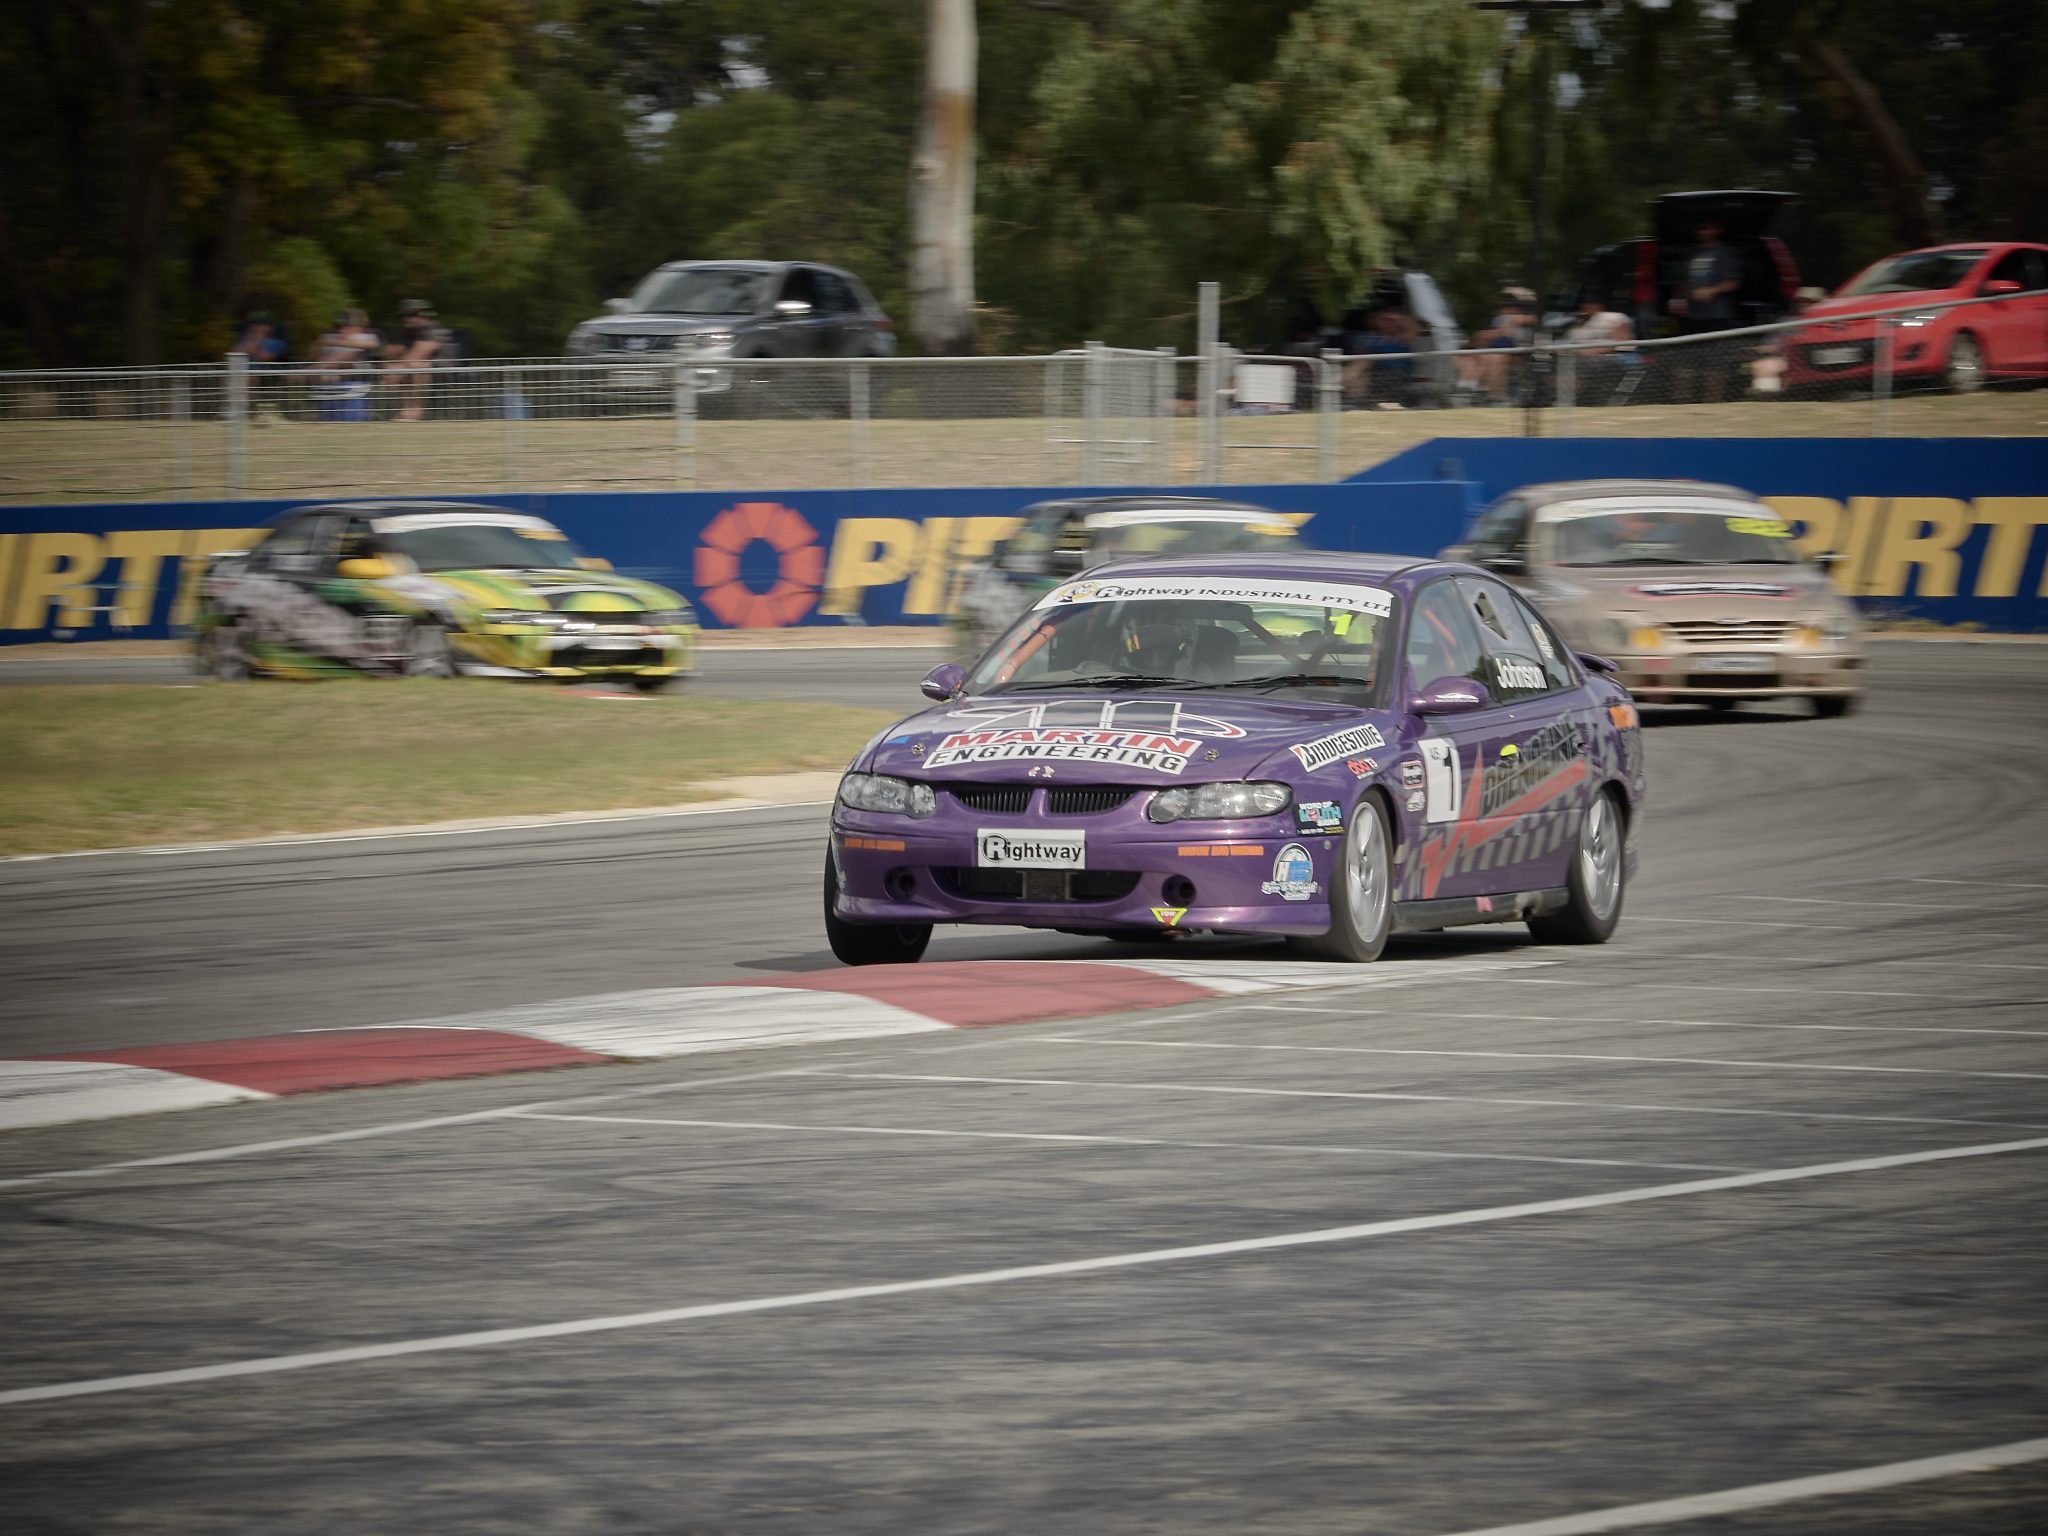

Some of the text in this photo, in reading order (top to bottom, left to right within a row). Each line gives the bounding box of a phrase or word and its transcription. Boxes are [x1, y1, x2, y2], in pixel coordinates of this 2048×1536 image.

[1199, 588, 1313, 601] INDUSTRIAL
[1321, 595, 1360, 605] PTY
[1495, 657, 1548, 689] Johnson
[945, 730, 1200, 755] MARTIN
[1299, 726, 1383, 768] BRIDGESTONE
[930, 744, 1185, 772] ENGINEERING
[982, 833, 1082, 862] Rightway
